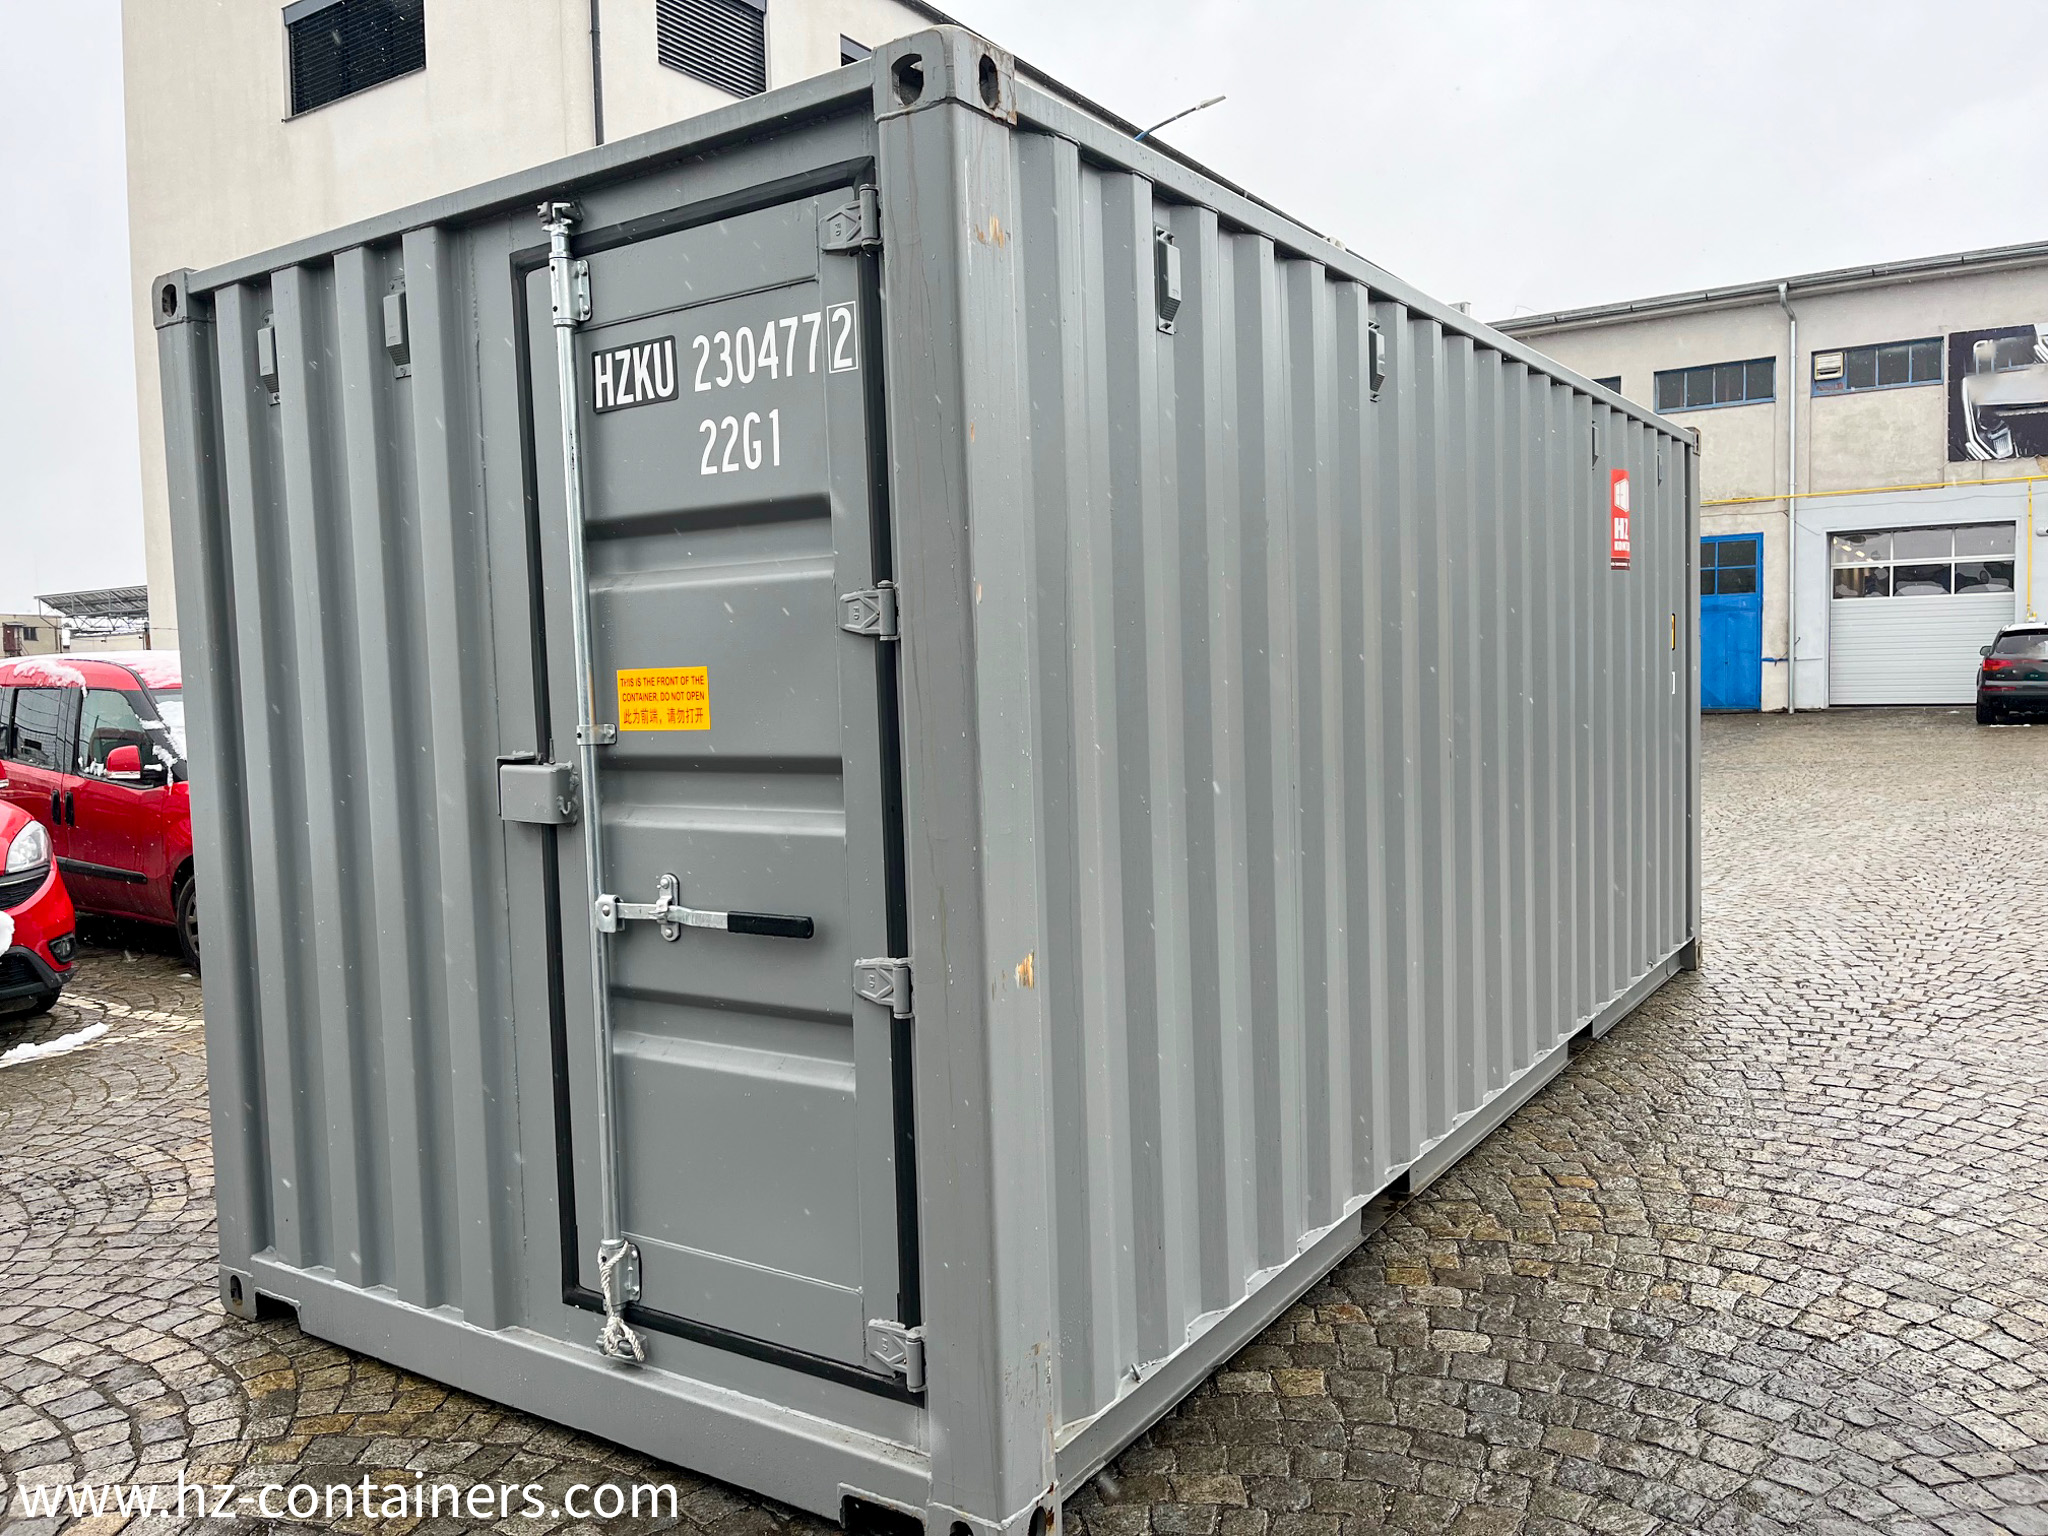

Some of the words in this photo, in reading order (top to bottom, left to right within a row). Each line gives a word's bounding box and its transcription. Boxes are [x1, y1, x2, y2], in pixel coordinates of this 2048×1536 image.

[594, 339, 676, 409] HZKU
[692, 312, 822, 392] 230477
[831, 307, 854, 369] 2
[699, 408, 781, 476] 22G1
[620, 678, 634, 687] THIS
[635, 678, 642, 686] IS
[643, 677, 655, 687] THE
[656, 676, 679, 686] FRONT
[680, 675, 689, 685] OF
[691, 675, 704, 685] THE
[660, 692, 670, 701] DO
[671, 691, 685, 701] NOT
[686, 691, 705, 700] OPEN
